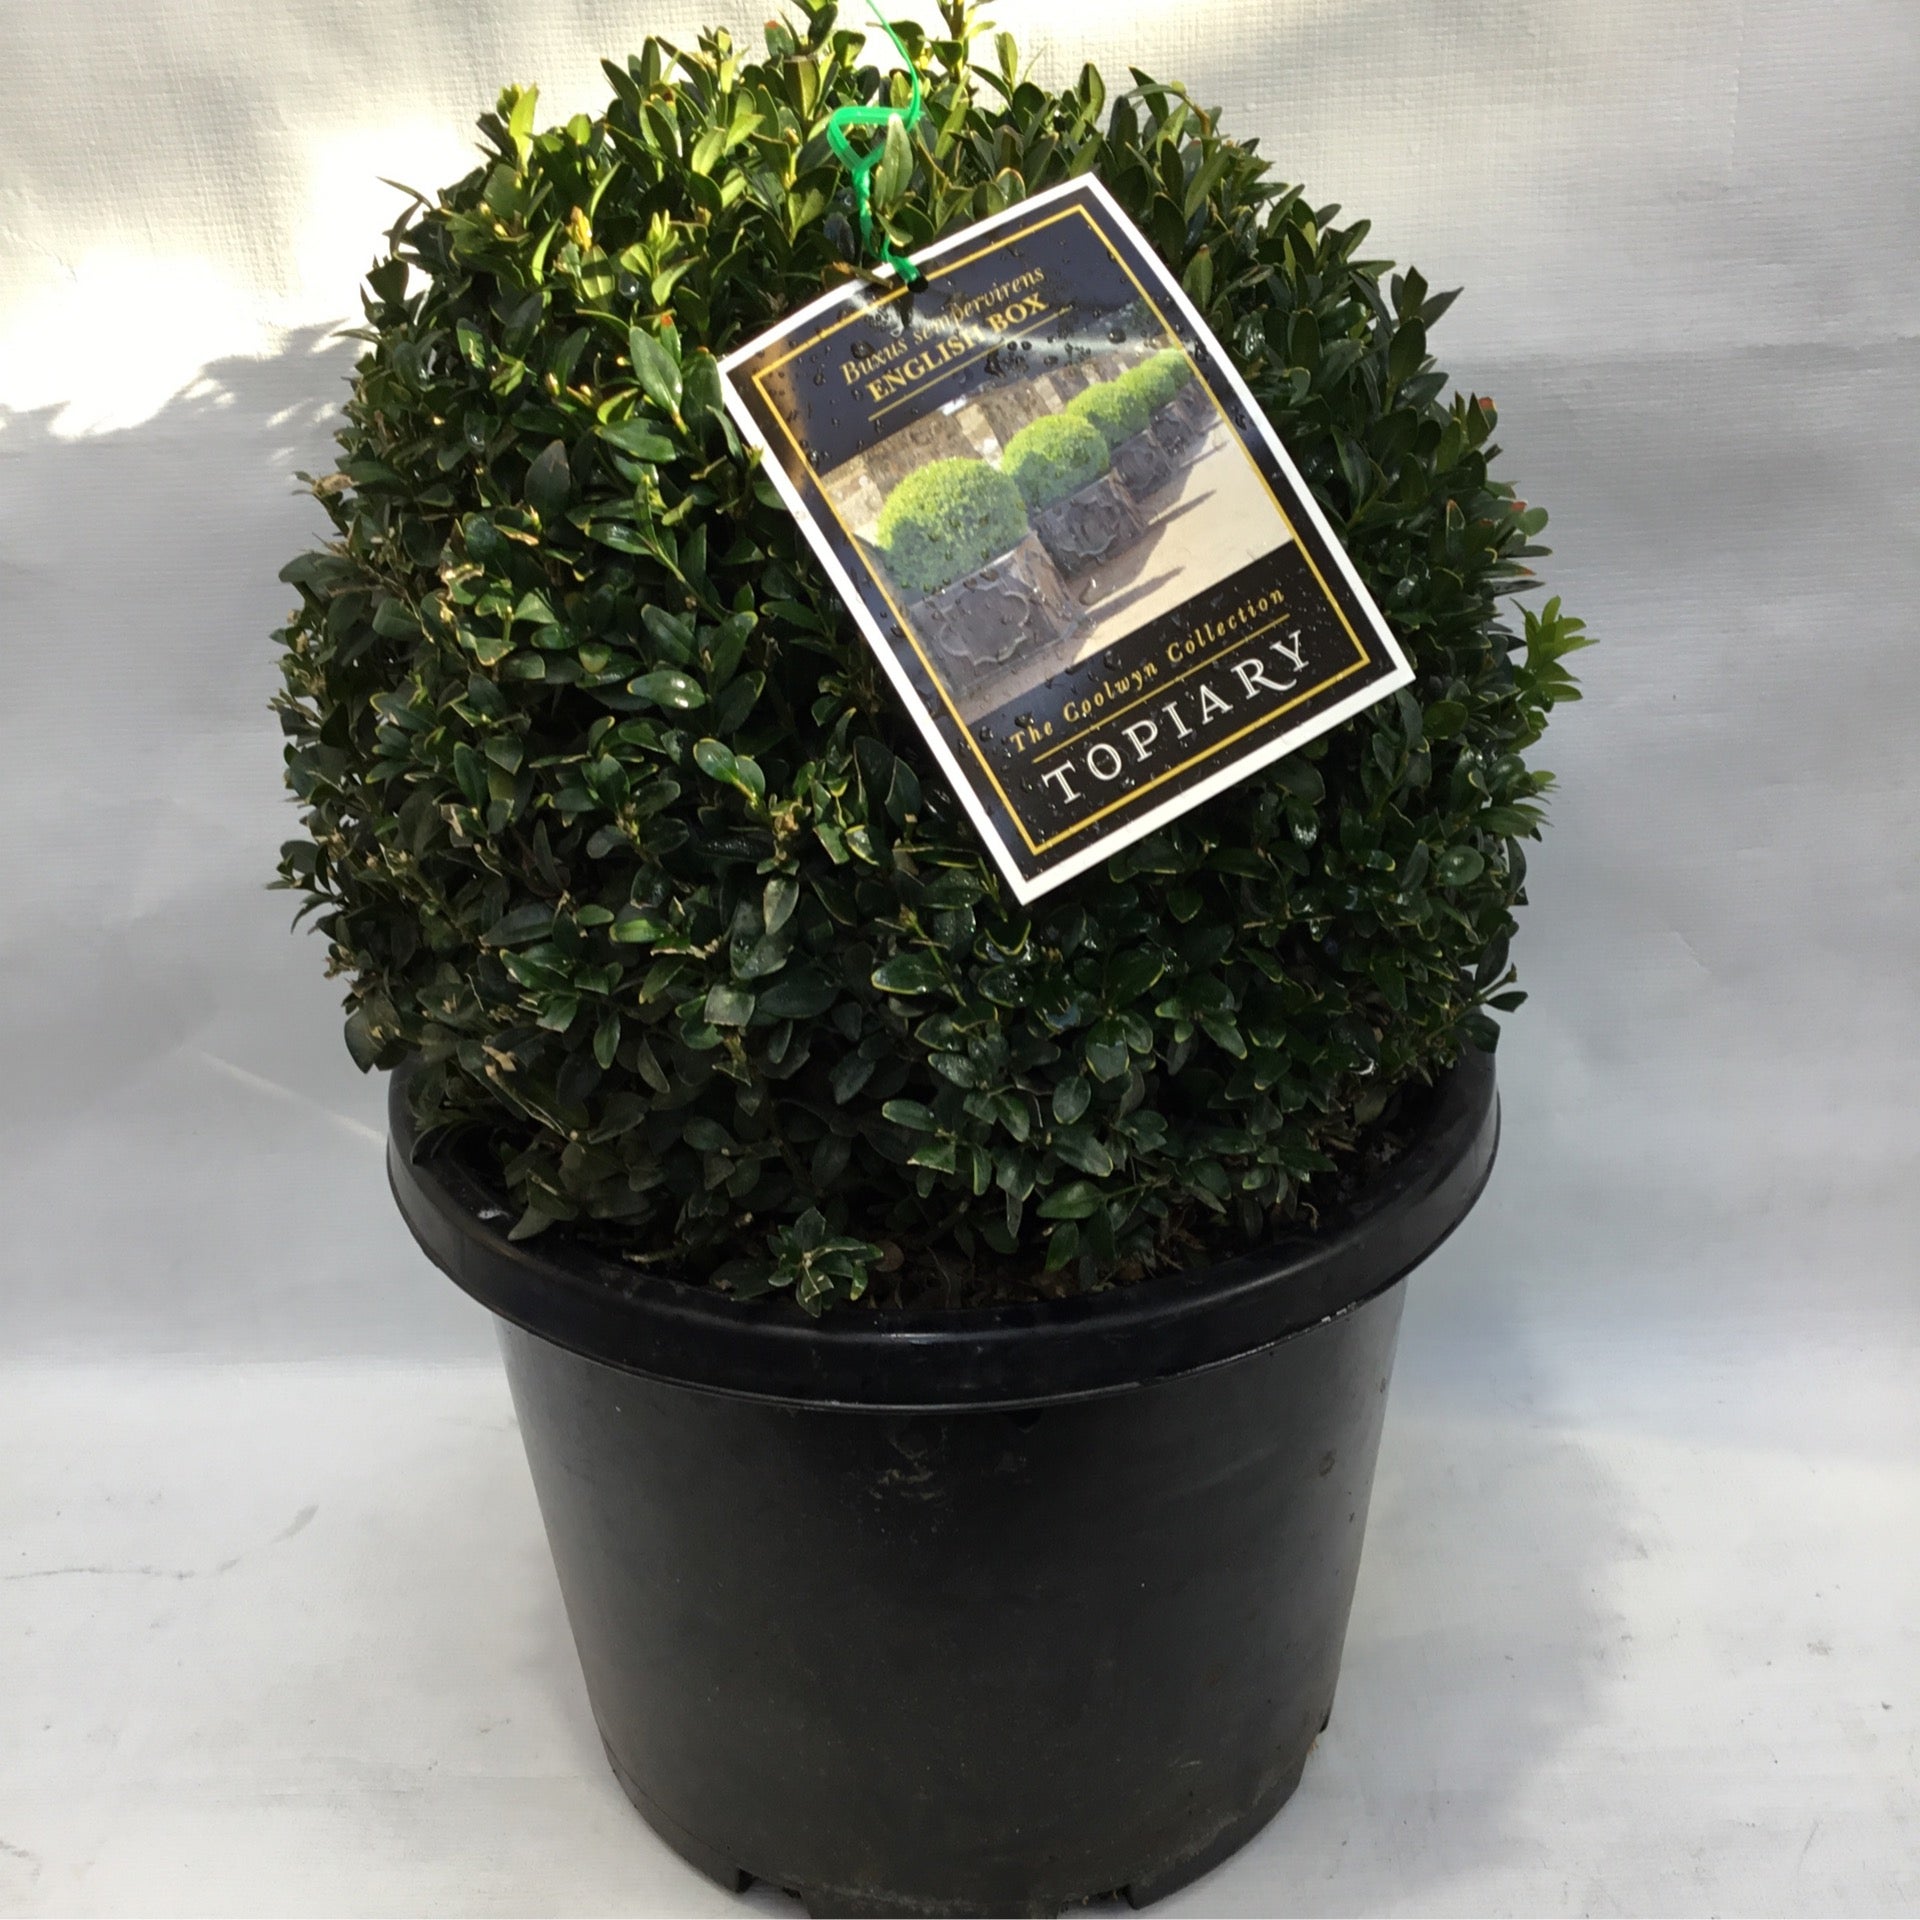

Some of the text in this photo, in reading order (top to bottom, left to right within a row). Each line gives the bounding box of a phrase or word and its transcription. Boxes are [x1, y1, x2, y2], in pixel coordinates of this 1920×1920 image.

[840, 267, 1045, 385] Buxus sempervirens
[867, 293, 1048, 402] ENGLISH BOX
[1009, 724, 1053, 752] The
[1166, 588, 1284, 663] Collection
[1041, 630, 1309, 804] TOPIARY
